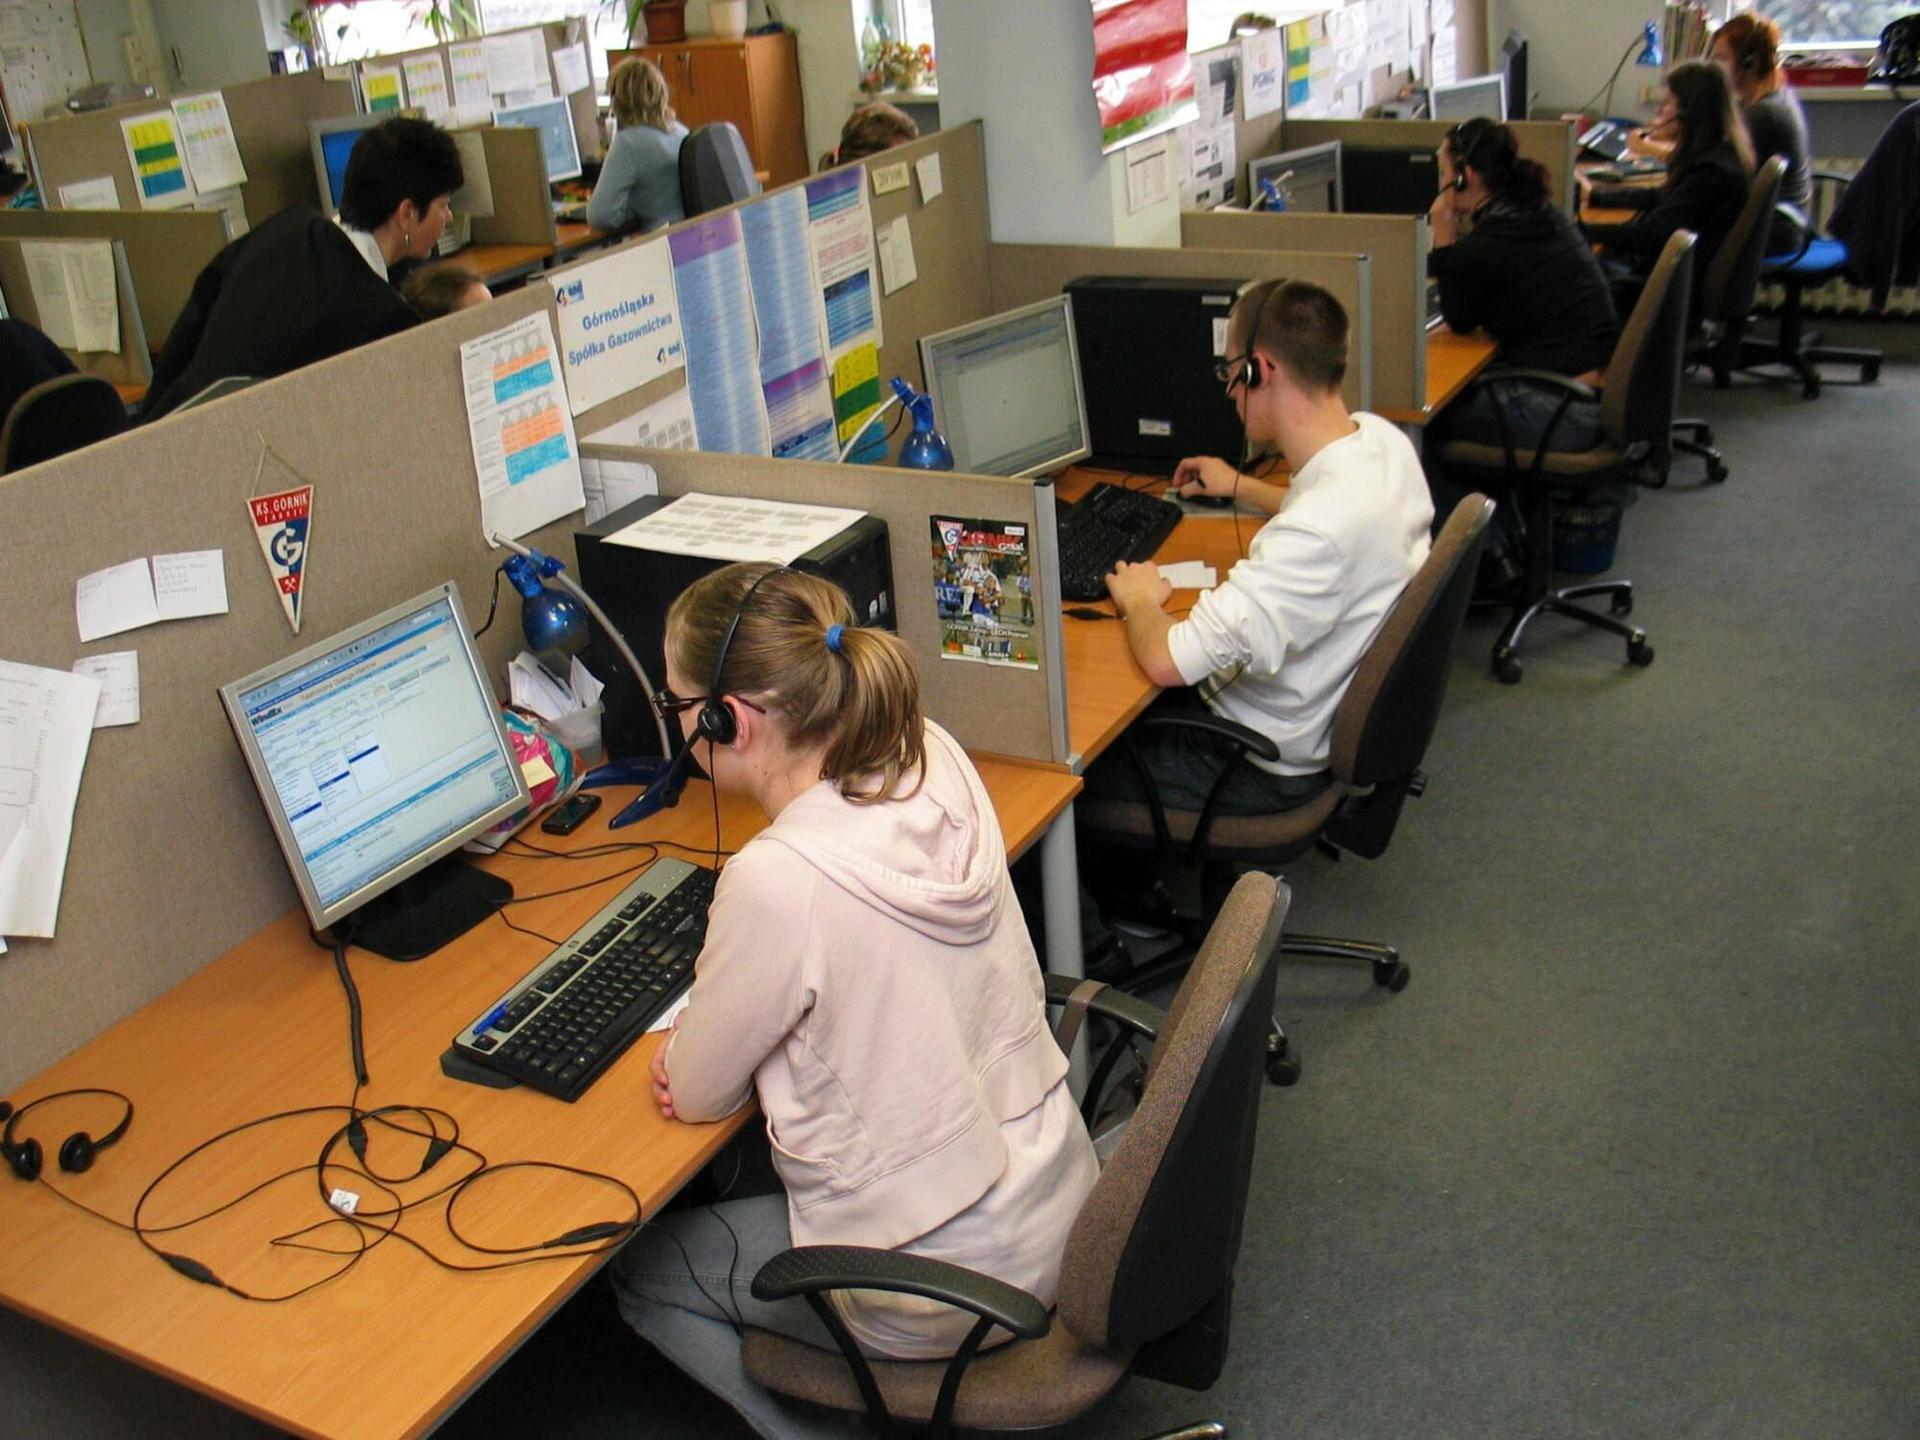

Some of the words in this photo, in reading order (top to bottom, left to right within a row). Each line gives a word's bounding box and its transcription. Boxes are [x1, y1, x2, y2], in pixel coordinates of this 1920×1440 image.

[582, 294, 655, 330] Górnośląska
[568, 340, 606, 368] Spółka
[607, 313, 673, 349] Gazownictwa
